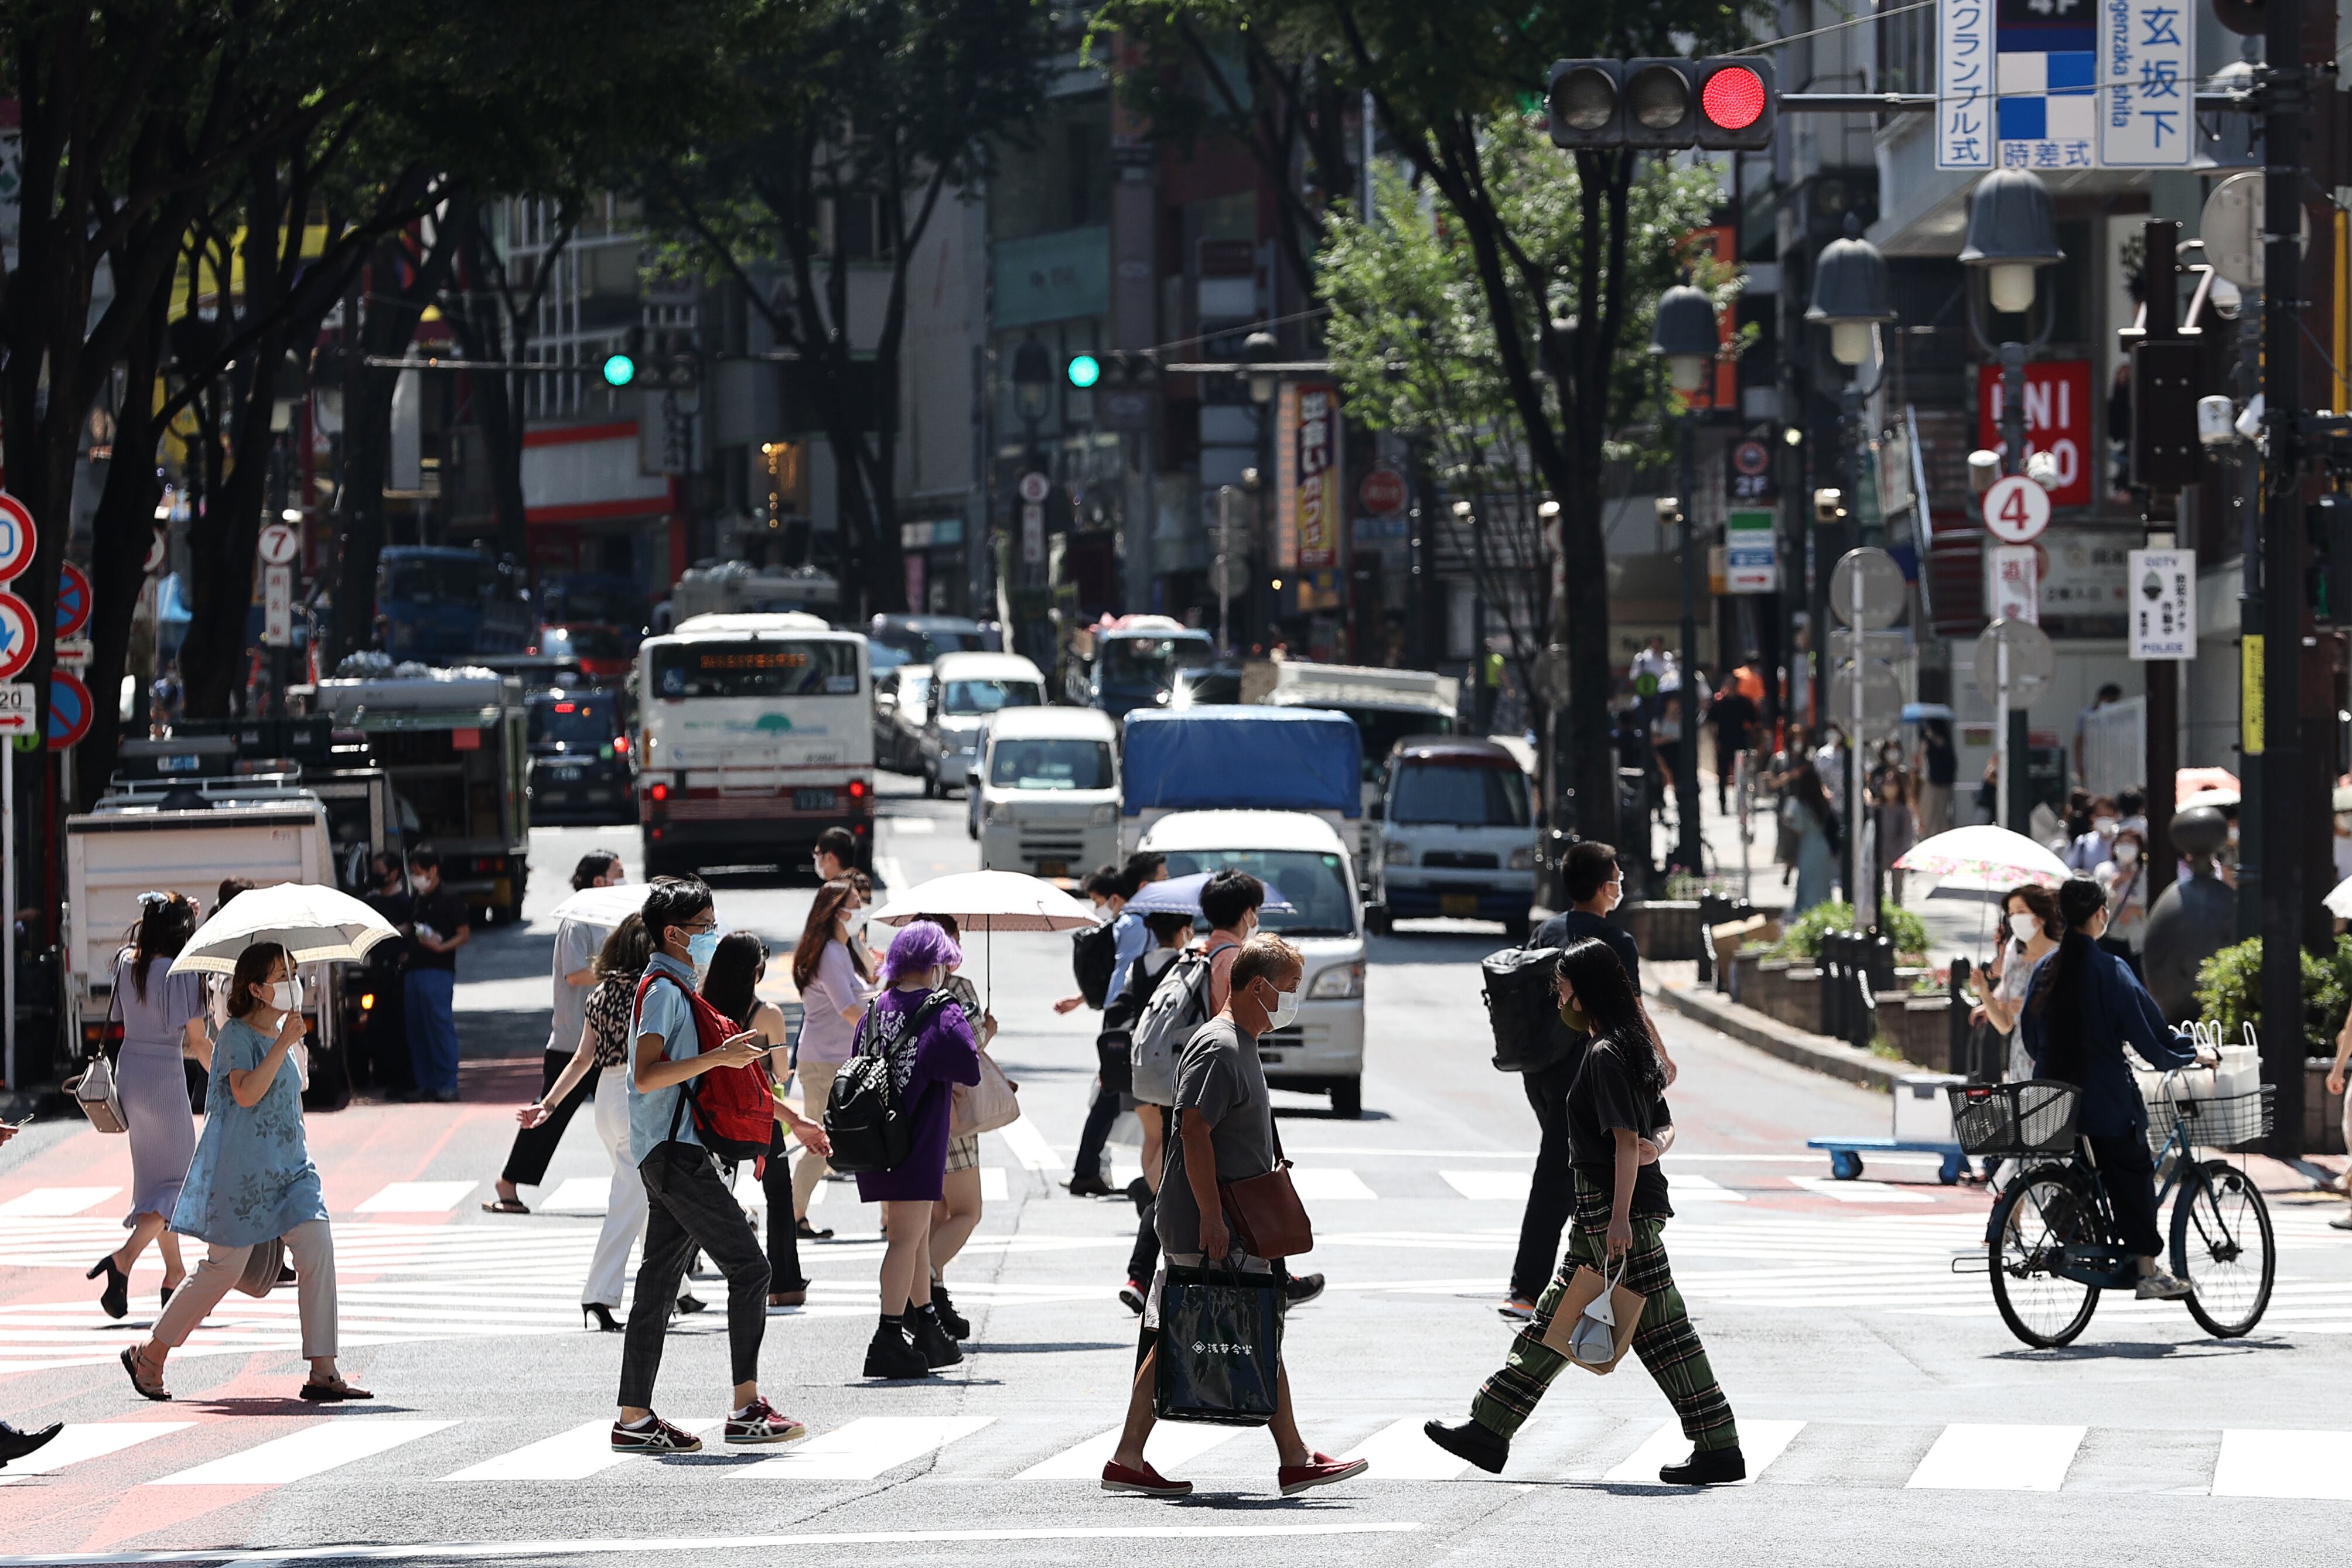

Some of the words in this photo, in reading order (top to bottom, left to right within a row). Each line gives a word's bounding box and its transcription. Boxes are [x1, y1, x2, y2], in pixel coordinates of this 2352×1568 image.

[2109, 0, 2132, 76] genzaka
[1950, 0, 1982, 162] クランブル式
[2139, 6, 2181, 148] 玄坂下
[2112, 86, 2132, 128] shita
[2003, 141, 2091, 169] 時差式
[1999, 487, 2029, 531] 4
[269, 531, 287, 557] 7
[1207, 1343, 1252, 1355] 浅草今半
